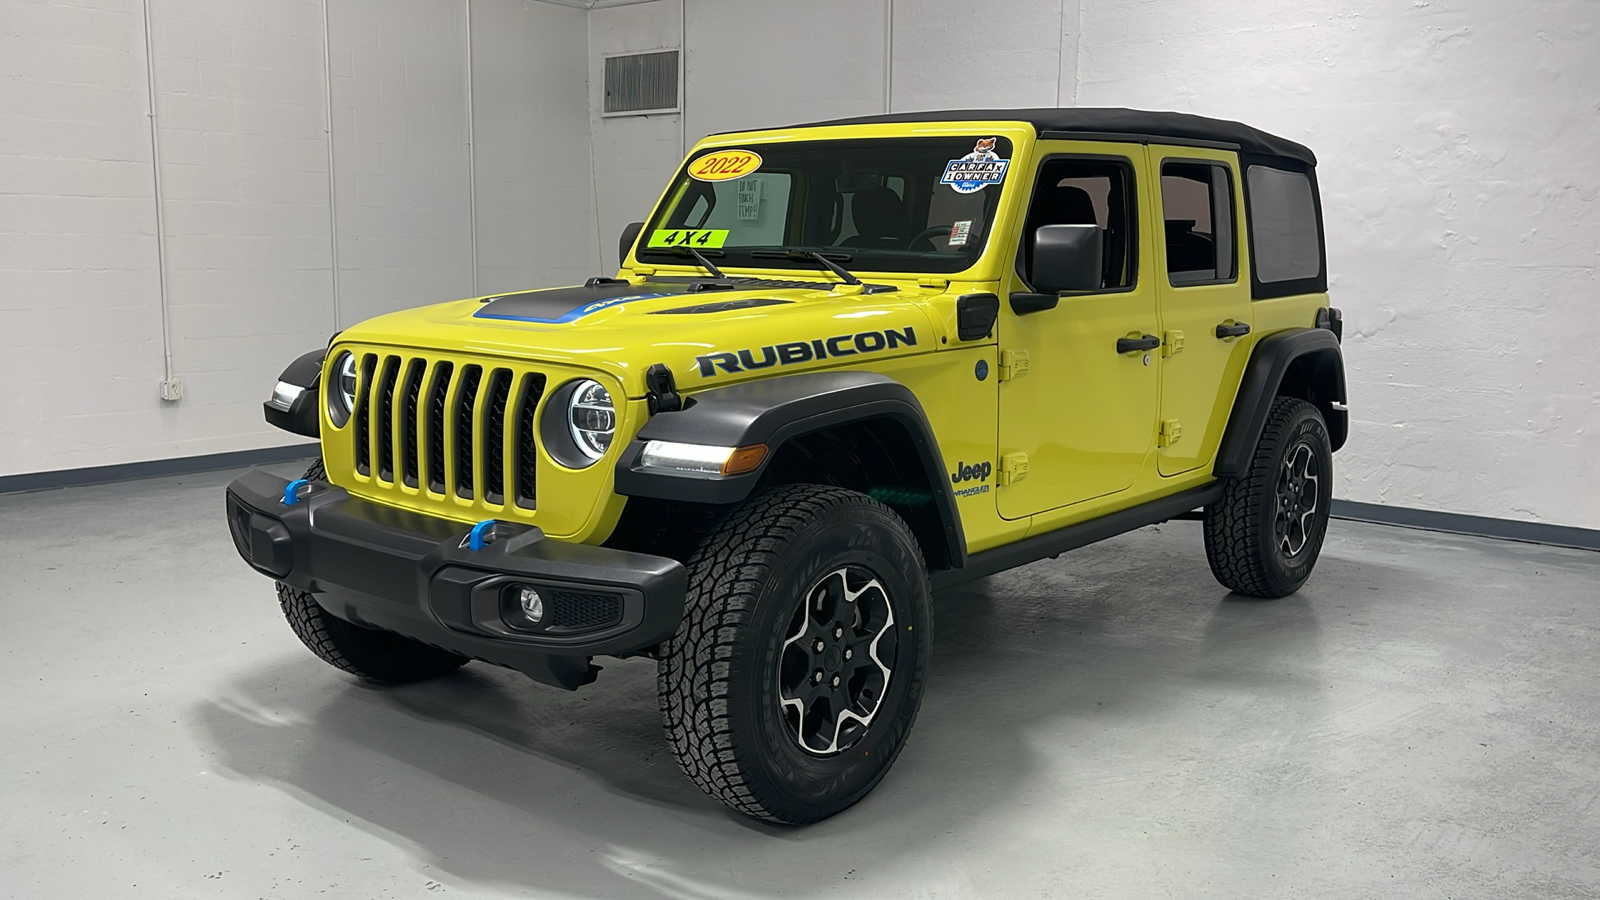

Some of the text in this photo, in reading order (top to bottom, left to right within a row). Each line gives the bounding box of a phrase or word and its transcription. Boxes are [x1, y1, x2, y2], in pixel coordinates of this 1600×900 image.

[697, 156, 752, 174] 2022
[950, 163, 1003, 171] CARFAX
[955, 172, 1000, 180] OWNER
[664, 231, 712, 245] 4X4
[696, 326, 917, 377] RUBICON
[951, 461, 991, 483] Jeep
[953, 485, 989, 496] WRANGLER
